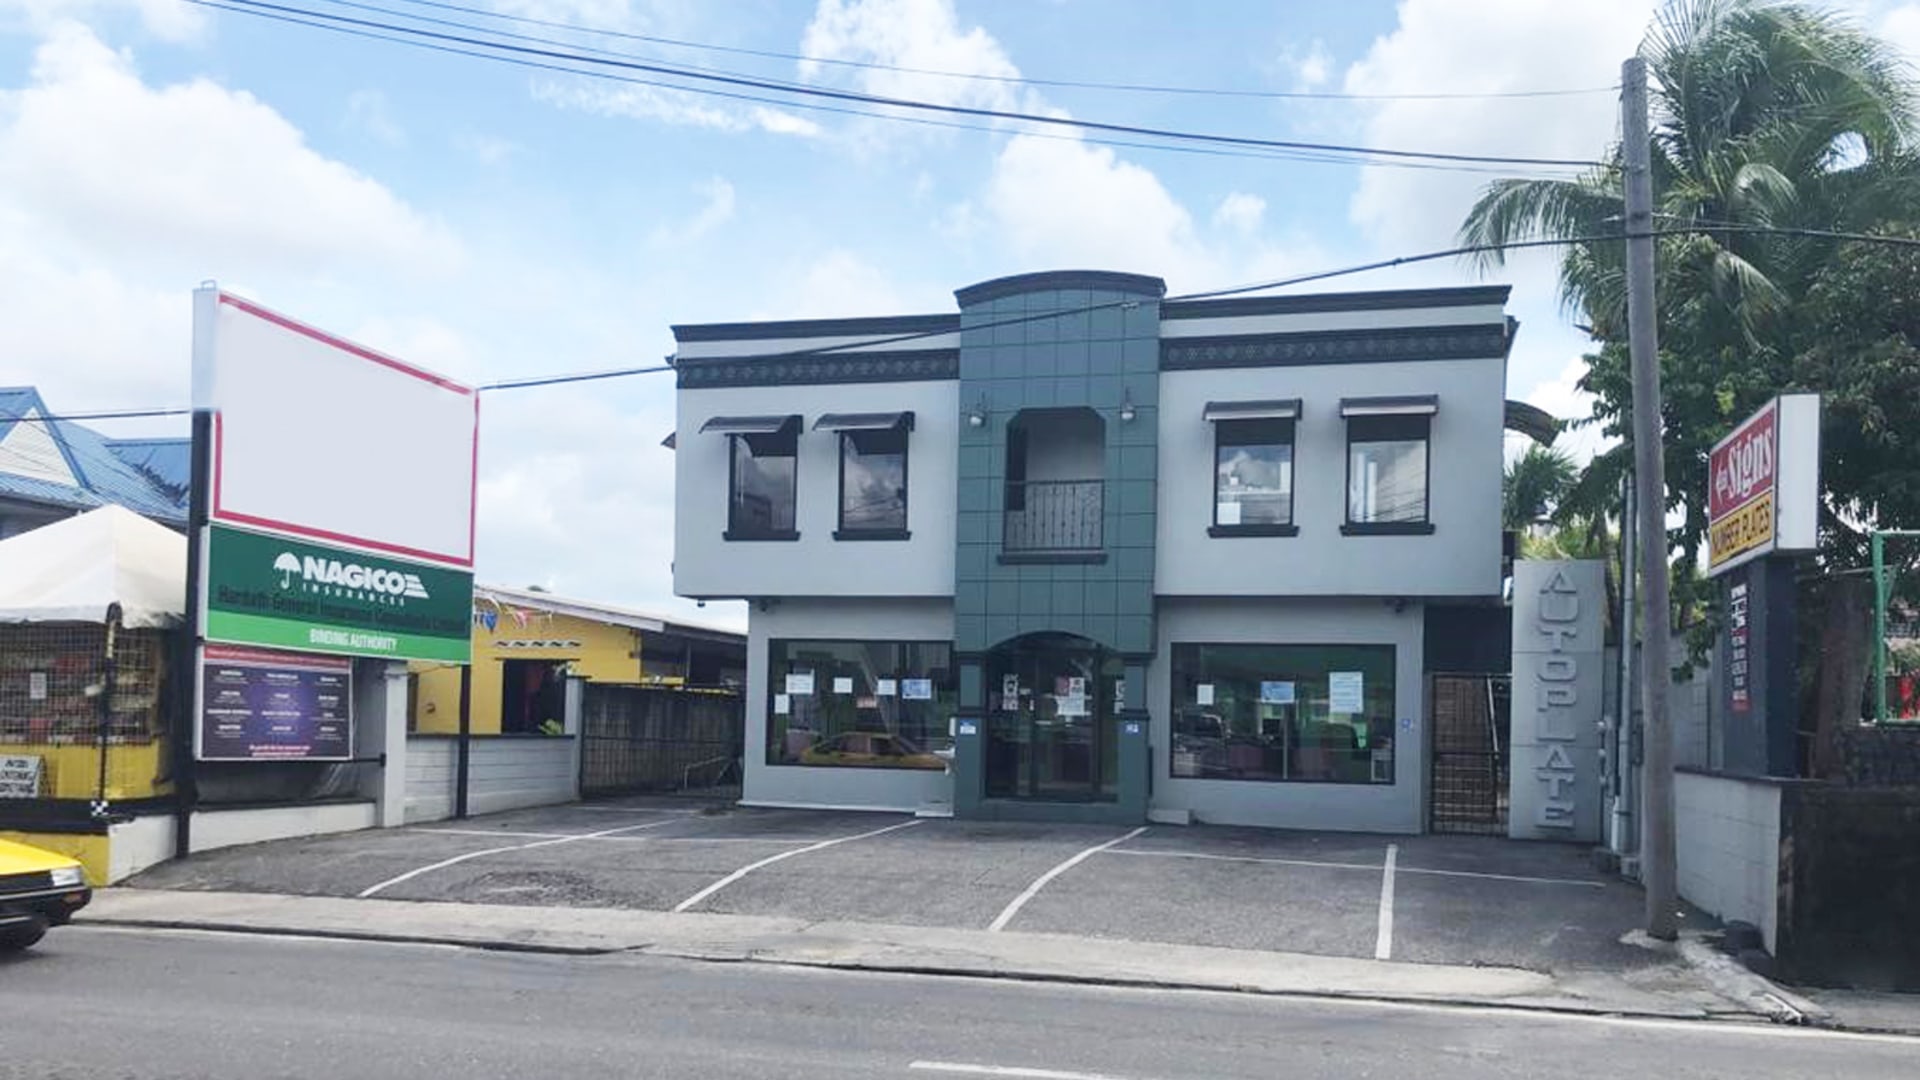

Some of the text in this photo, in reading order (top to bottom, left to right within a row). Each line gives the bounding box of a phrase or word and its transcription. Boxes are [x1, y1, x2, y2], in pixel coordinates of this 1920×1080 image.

[1728, 429, 1772, 498] Signs
[1711, 500, 1770, 555] NUMBER PLATES
[302, 583, 405, 606] INSURANCES
[303, 556, 405, 595] NAGICO
[310, 628, 397, 651] BINDING AUTHORITY
[1536, 568, 1578, 829] AUTOPLATE
